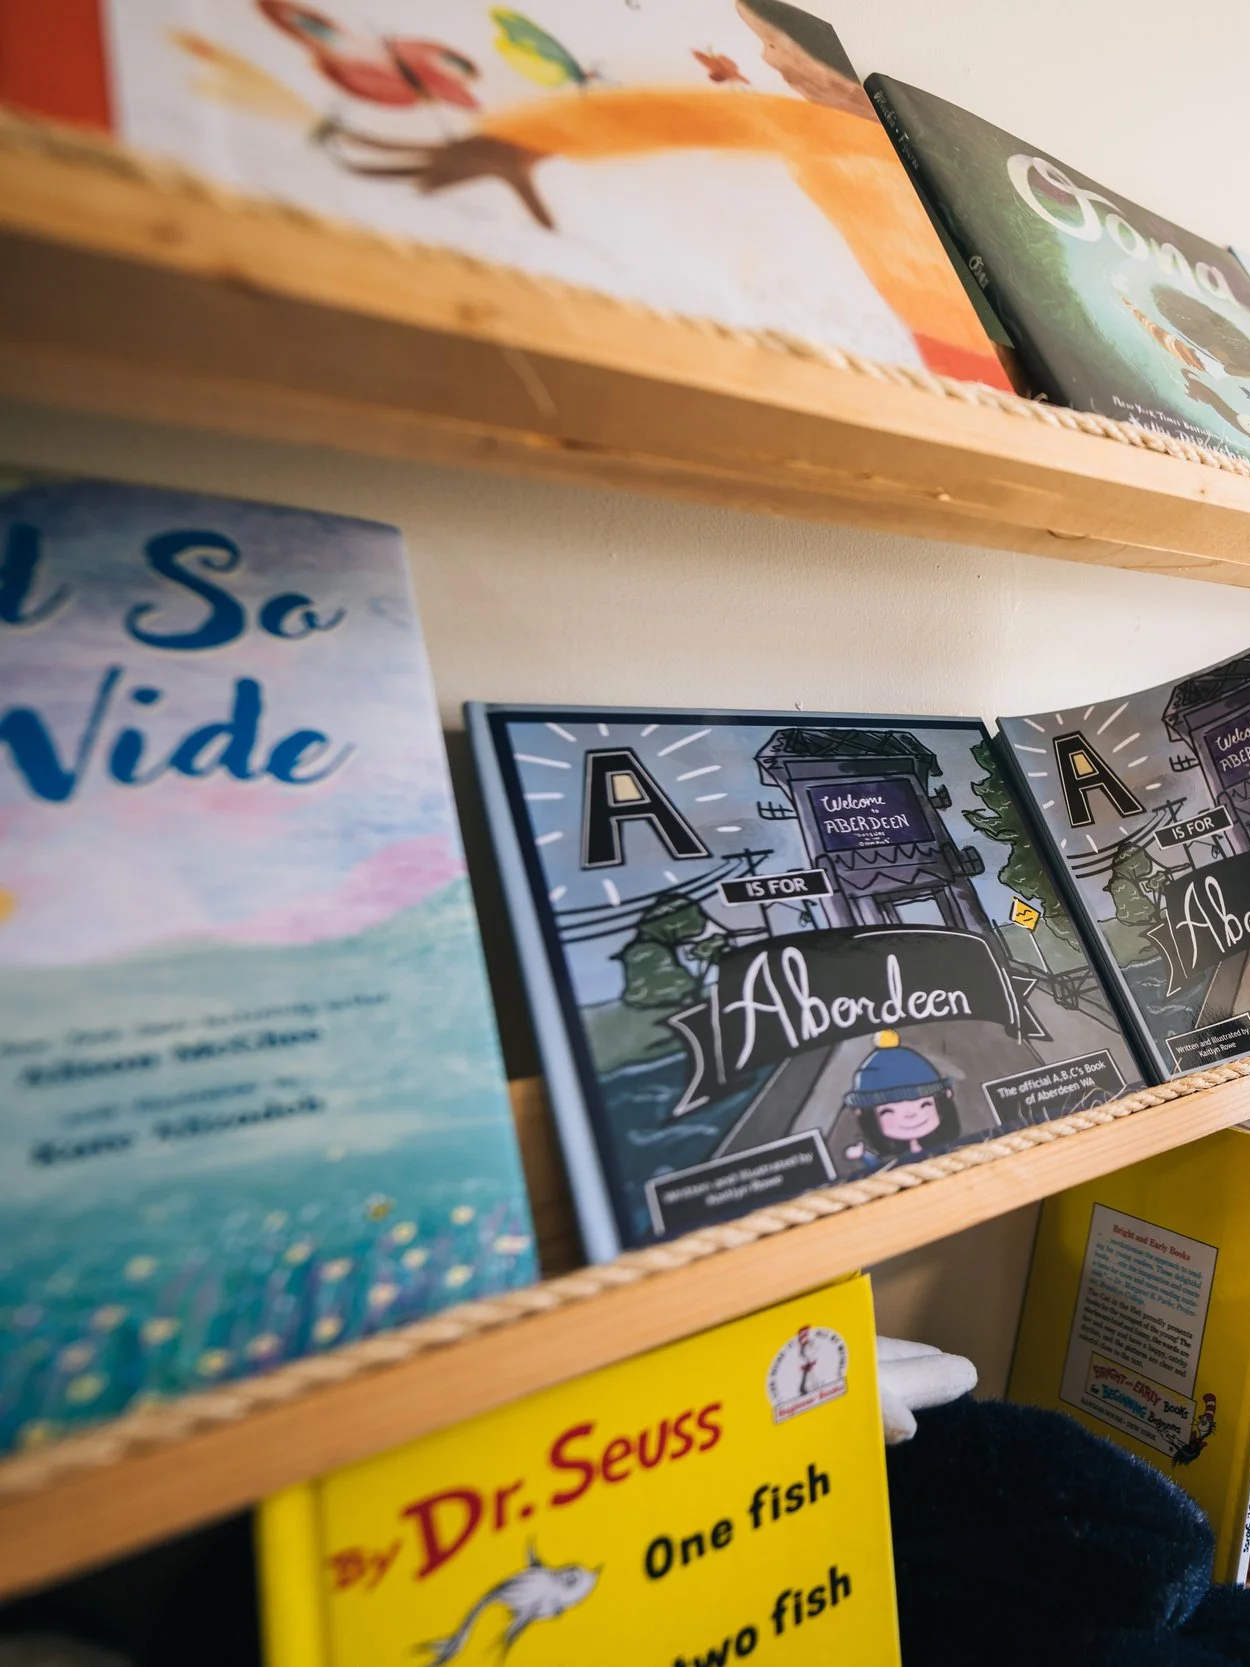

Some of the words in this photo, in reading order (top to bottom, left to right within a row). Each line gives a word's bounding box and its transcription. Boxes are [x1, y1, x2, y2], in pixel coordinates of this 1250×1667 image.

[1112, 394, 1134, 411] New
[1134, 404, 1156, 419] York
[1156, 411, 1181, 427] Times
[124, 528, 347, 652] So
[1053, 730, 1146, 828] A
[582, 747, 711, 870] A
[820, 794, 886, 812] Welcome
[824, 813, 910, 834] ABERDEEN
[1172, 822, 1186, 841] IS
[1187, 815, 1215, 834] FOR
[745, 879, 769, 896] IS
[773, 876, 808, 895] FOR
[723, 946, 973, 1071] Aberdeen
[1176, 1042, 1199, 1054] Written
[1200, 1038, 1212, 1047] and
[1211, 1030, 1242, 1044] Illustrated
[1241, 1027, 1249, 1036] by
[1199, 1045, 1220, 1058] Kaitlyn
[1220, 1041, 1237, 1051] Rowe
[996, 1086, 1018, 1099] The
[1019, 1074, 1052, 1094] official
[1052, 1066, 1084, 1083] A,B,C's
[1085, 1060, 1106, 1074] Book
[1025, 1094, 1036, 1106] of
[1037, 1081, 1080, 1102] Aberdeen
[1080, 1076, 1096, 1088] WA
[1113, 1224, 1135, 1240] Bright
[1136, 1234, 1148, 1245] and
[1149, 1238, 1168, 1253] Early
[1169, 1246, 1191, 1261] Books
[1119, 1302, 1129, 1310] the
[1180, 1337, 1192, 1349] The
[1092, 1365, 1128, 1385] BRIGHT
[1133, 1380, 1162, 1406] EARLY
[328, 1537, 404, 1591] By
[401, 1482, 535, 1581] Dr.
[547, 1401, 724, 1508] Seuss
[644, 1516, 735, 1582] One
[749, 1462, 833, 1530] fish
[672, 1624, 760, 1667] wo
[770, 1566, 853, 1636] fish
